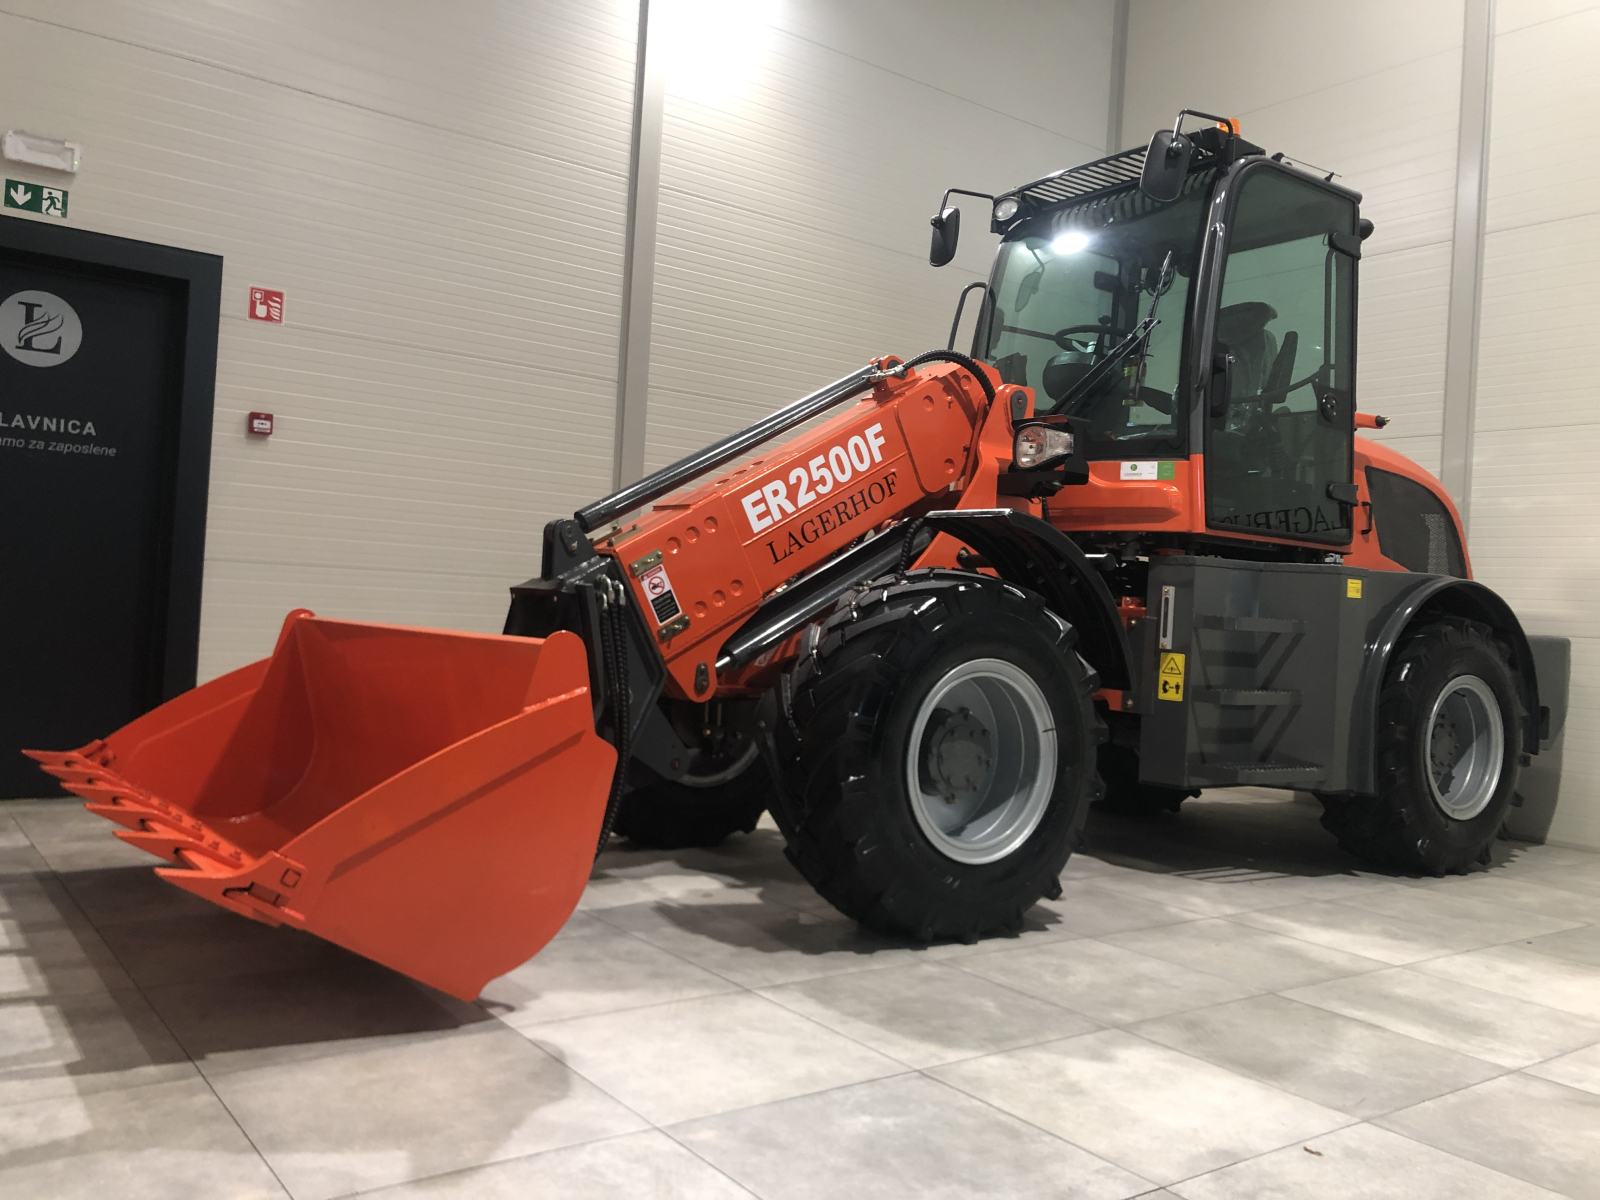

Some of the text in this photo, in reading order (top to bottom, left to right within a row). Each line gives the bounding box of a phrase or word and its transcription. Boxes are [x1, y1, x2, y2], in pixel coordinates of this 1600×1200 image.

[0, 411, 97, 436] LAVNICA
[28, 439, 45, 450] za
[48, 441, 117, 457] zaposlene
[741, 422, 886, 534] ER2500F
[765, 471, 898, 565] LAGERHOF
